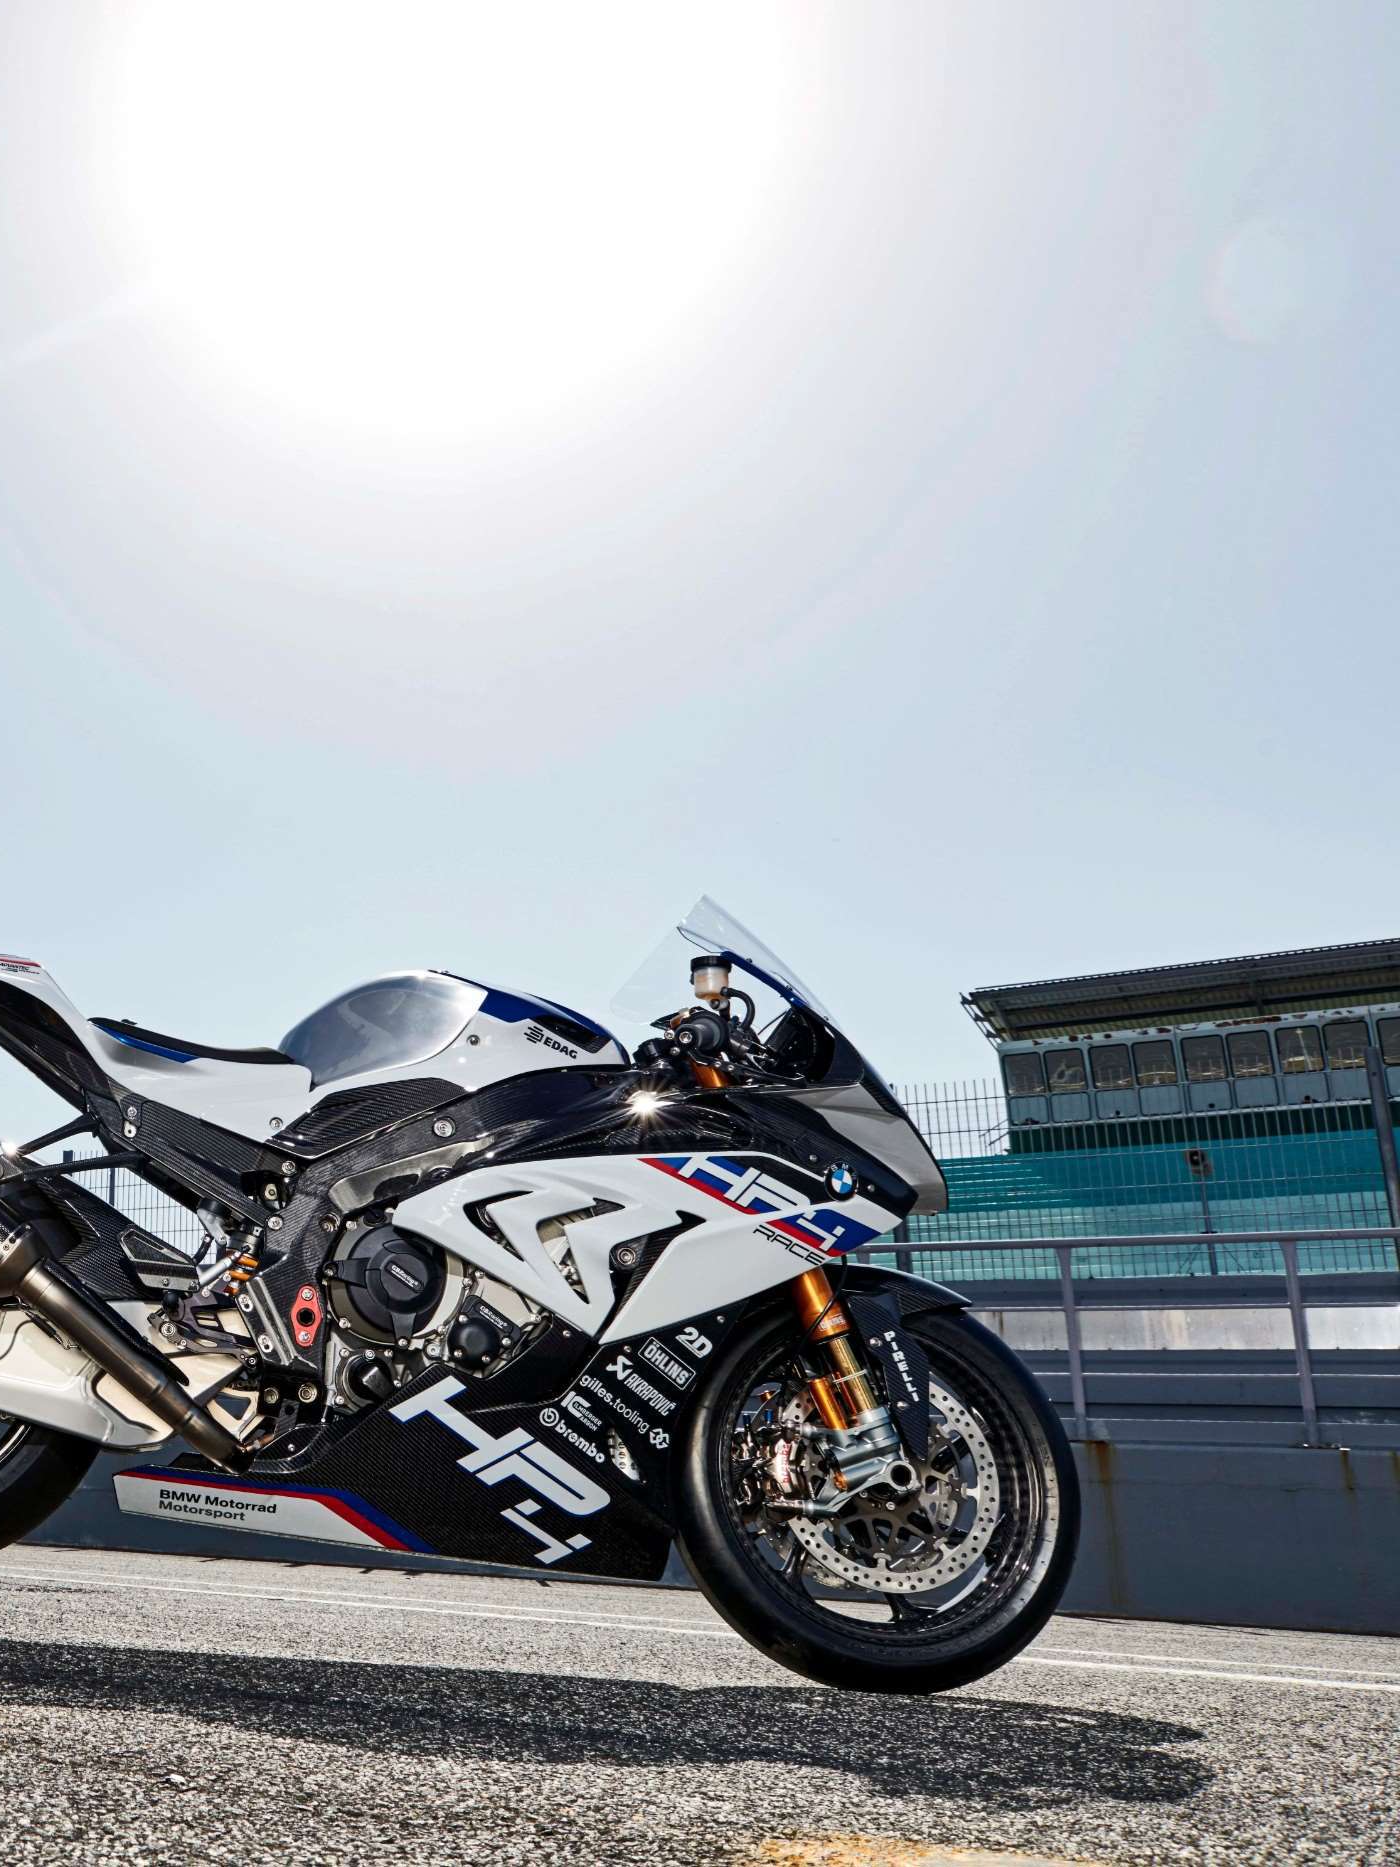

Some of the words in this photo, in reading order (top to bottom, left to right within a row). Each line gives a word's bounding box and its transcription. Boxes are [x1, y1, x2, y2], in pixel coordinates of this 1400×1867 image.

[543, 1037, 578, 1059] EDAG
[752, 1224, 829, 1266] RACE
[643, 1341, 690, 1385] ÖHLINS
[675, 1326, 713, 1358] 2D
[884, 1330, 919, 1402] PIRELLI
[579, 1374, 650, 1434] gilles.tooling
[555, 1419, 606, 1463] brembo
[158, 1499, 246, 1521] Motorsport
[159, 1488, 201, 1504] BMW
[204, 1494, 277, 1514] Motorrad
